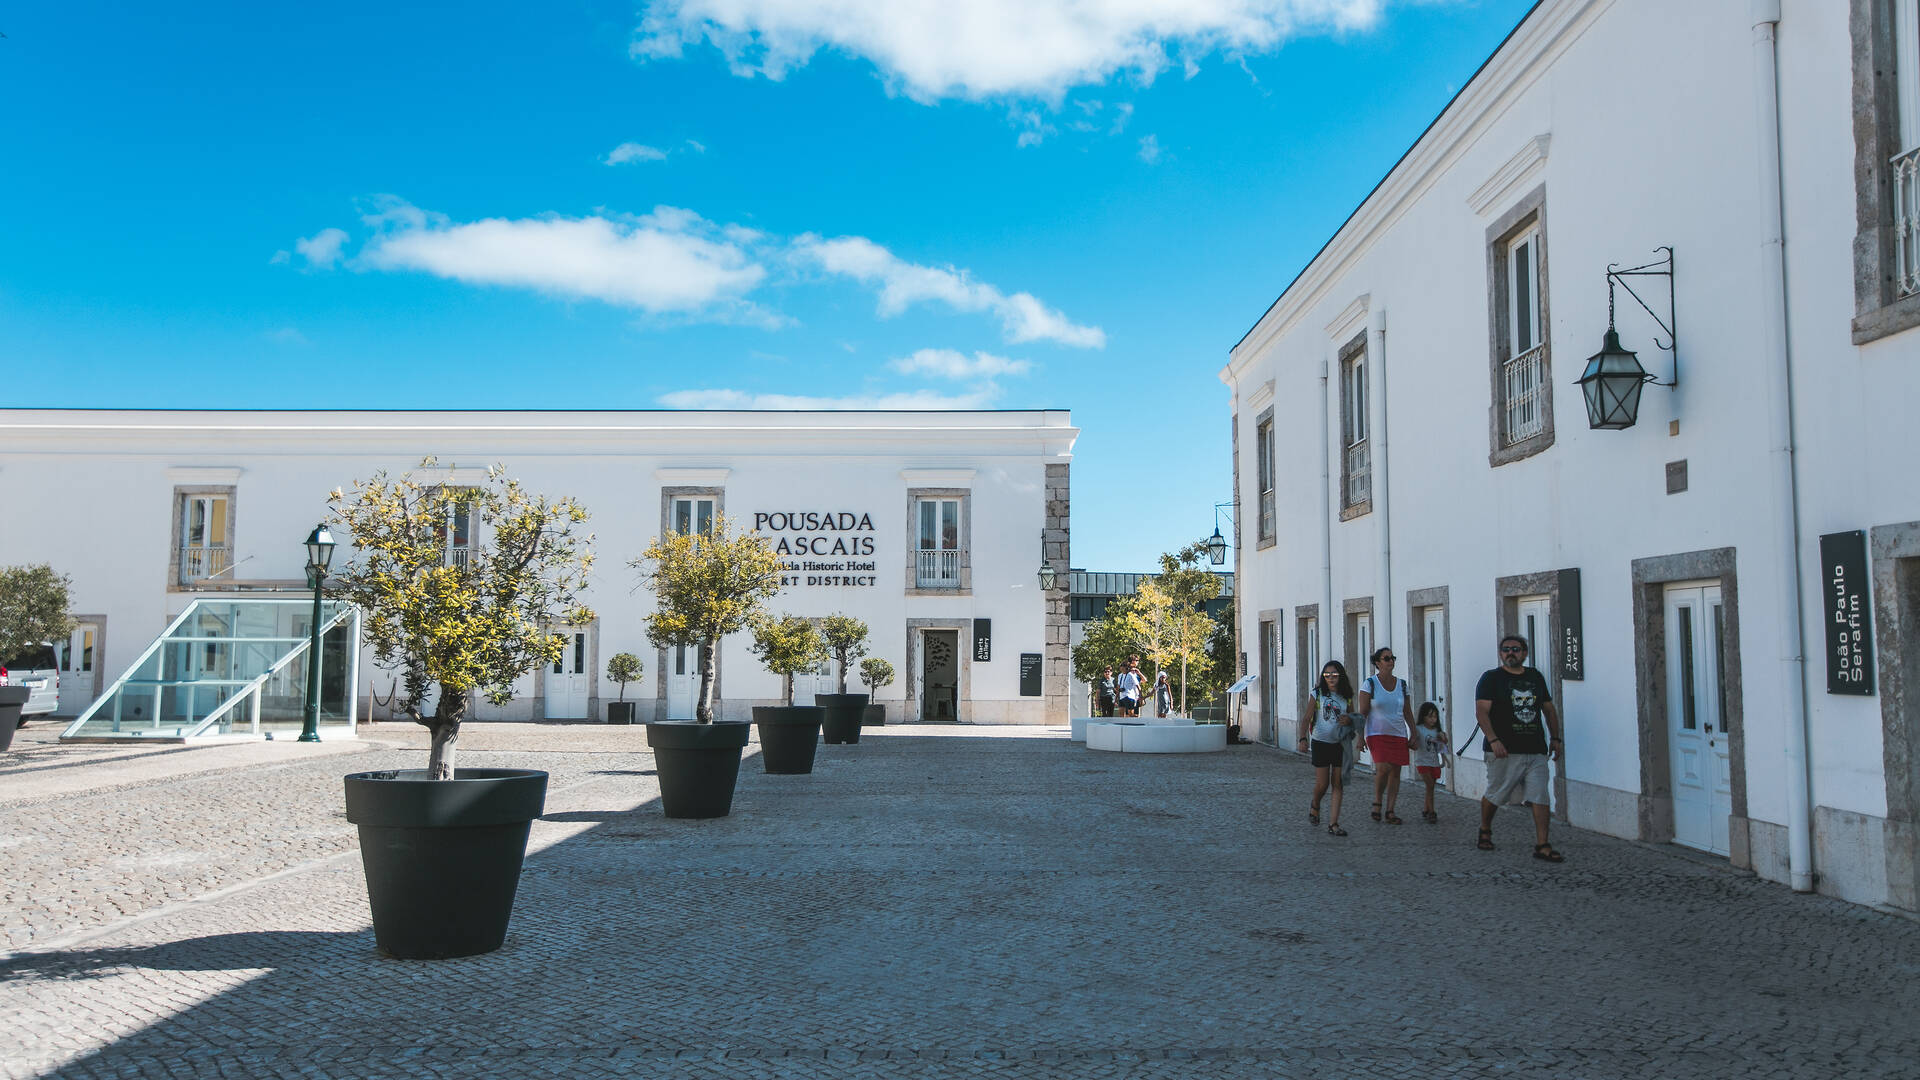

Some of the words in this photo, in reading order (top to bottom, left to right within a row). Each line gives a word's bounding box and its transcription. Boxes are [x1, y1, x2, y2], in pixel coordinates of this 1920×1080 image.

[754, 512, 875, 531] POUSADA
[759, 537, 875, 556] ASCAIS
[803, 561, 845, 571] Historic
[846, 561, 875, 571] Hotel
[807, 576, 876, 586] DISTRICT
[1833, 565, 1847, 624] Paulo
[1848, 594, 1863, 682] Serafim
[1837, 632, 1849, 682] João
